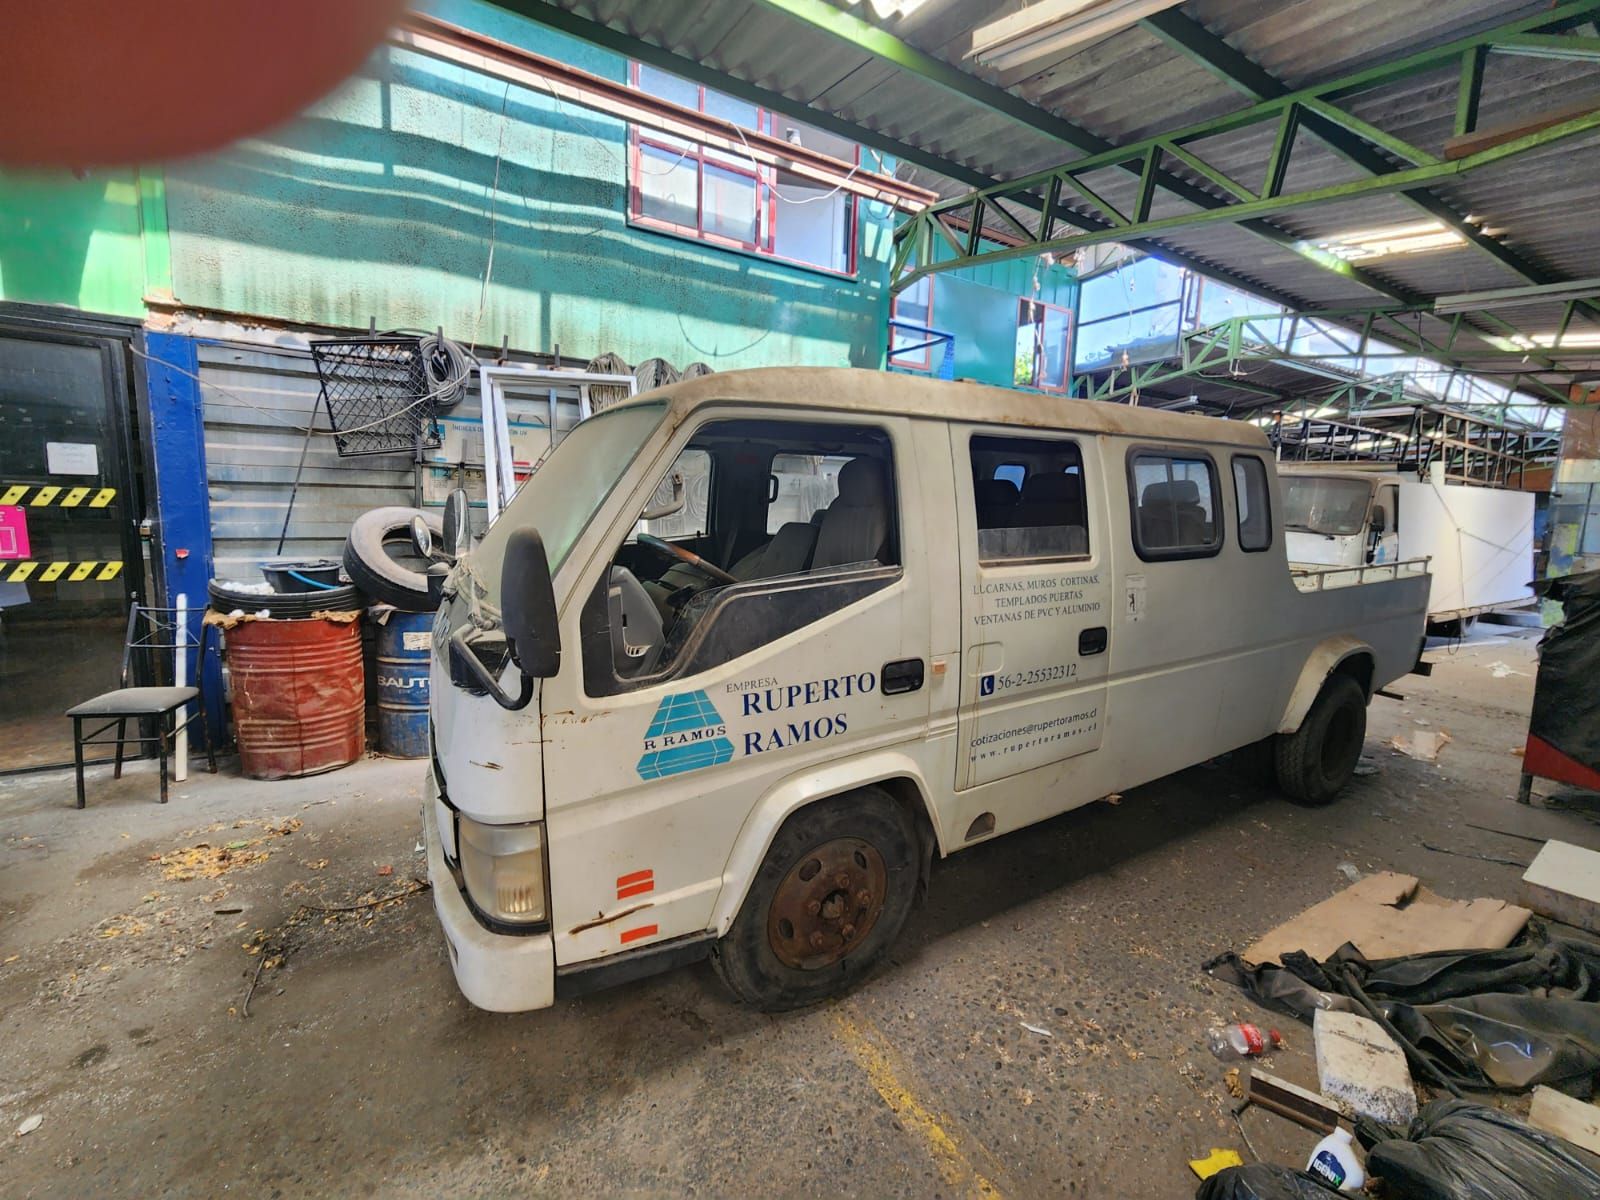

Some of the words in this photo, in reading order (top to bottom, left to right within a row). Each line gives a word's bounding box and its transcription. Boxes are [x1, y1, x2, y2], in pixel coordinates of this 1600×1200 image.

[1027, 578, 1057, 589] MUROS
[995, 594, 1048, 608] TEMPLADOS
[1049, 590, 1084, 601] PUERTAS
[974, 612, 1022, 625] VENTANAS
[1024, 608, 1036, 620] DE
[1037, 607, 1054, 618] PVC
[1055, 606, 1061, 616] Y
[1061, 602, 1100, 615] ALUMINIO
[377, 675, 431, 689] BAUT
[726, 677, 778, 693] EMPRESA
[997, 663, 1077, 690] 56-2-25532312
[742, 671, 876, 717] RUPERTO
[663, 725, 727, 747] RAMOS
[744, 713, 848, 756] RAMOS
[970, 708, 1097, 748] cotizaciones@rupertoramos.cl
[1313, 1158, 1341, 1186] IGENIX
